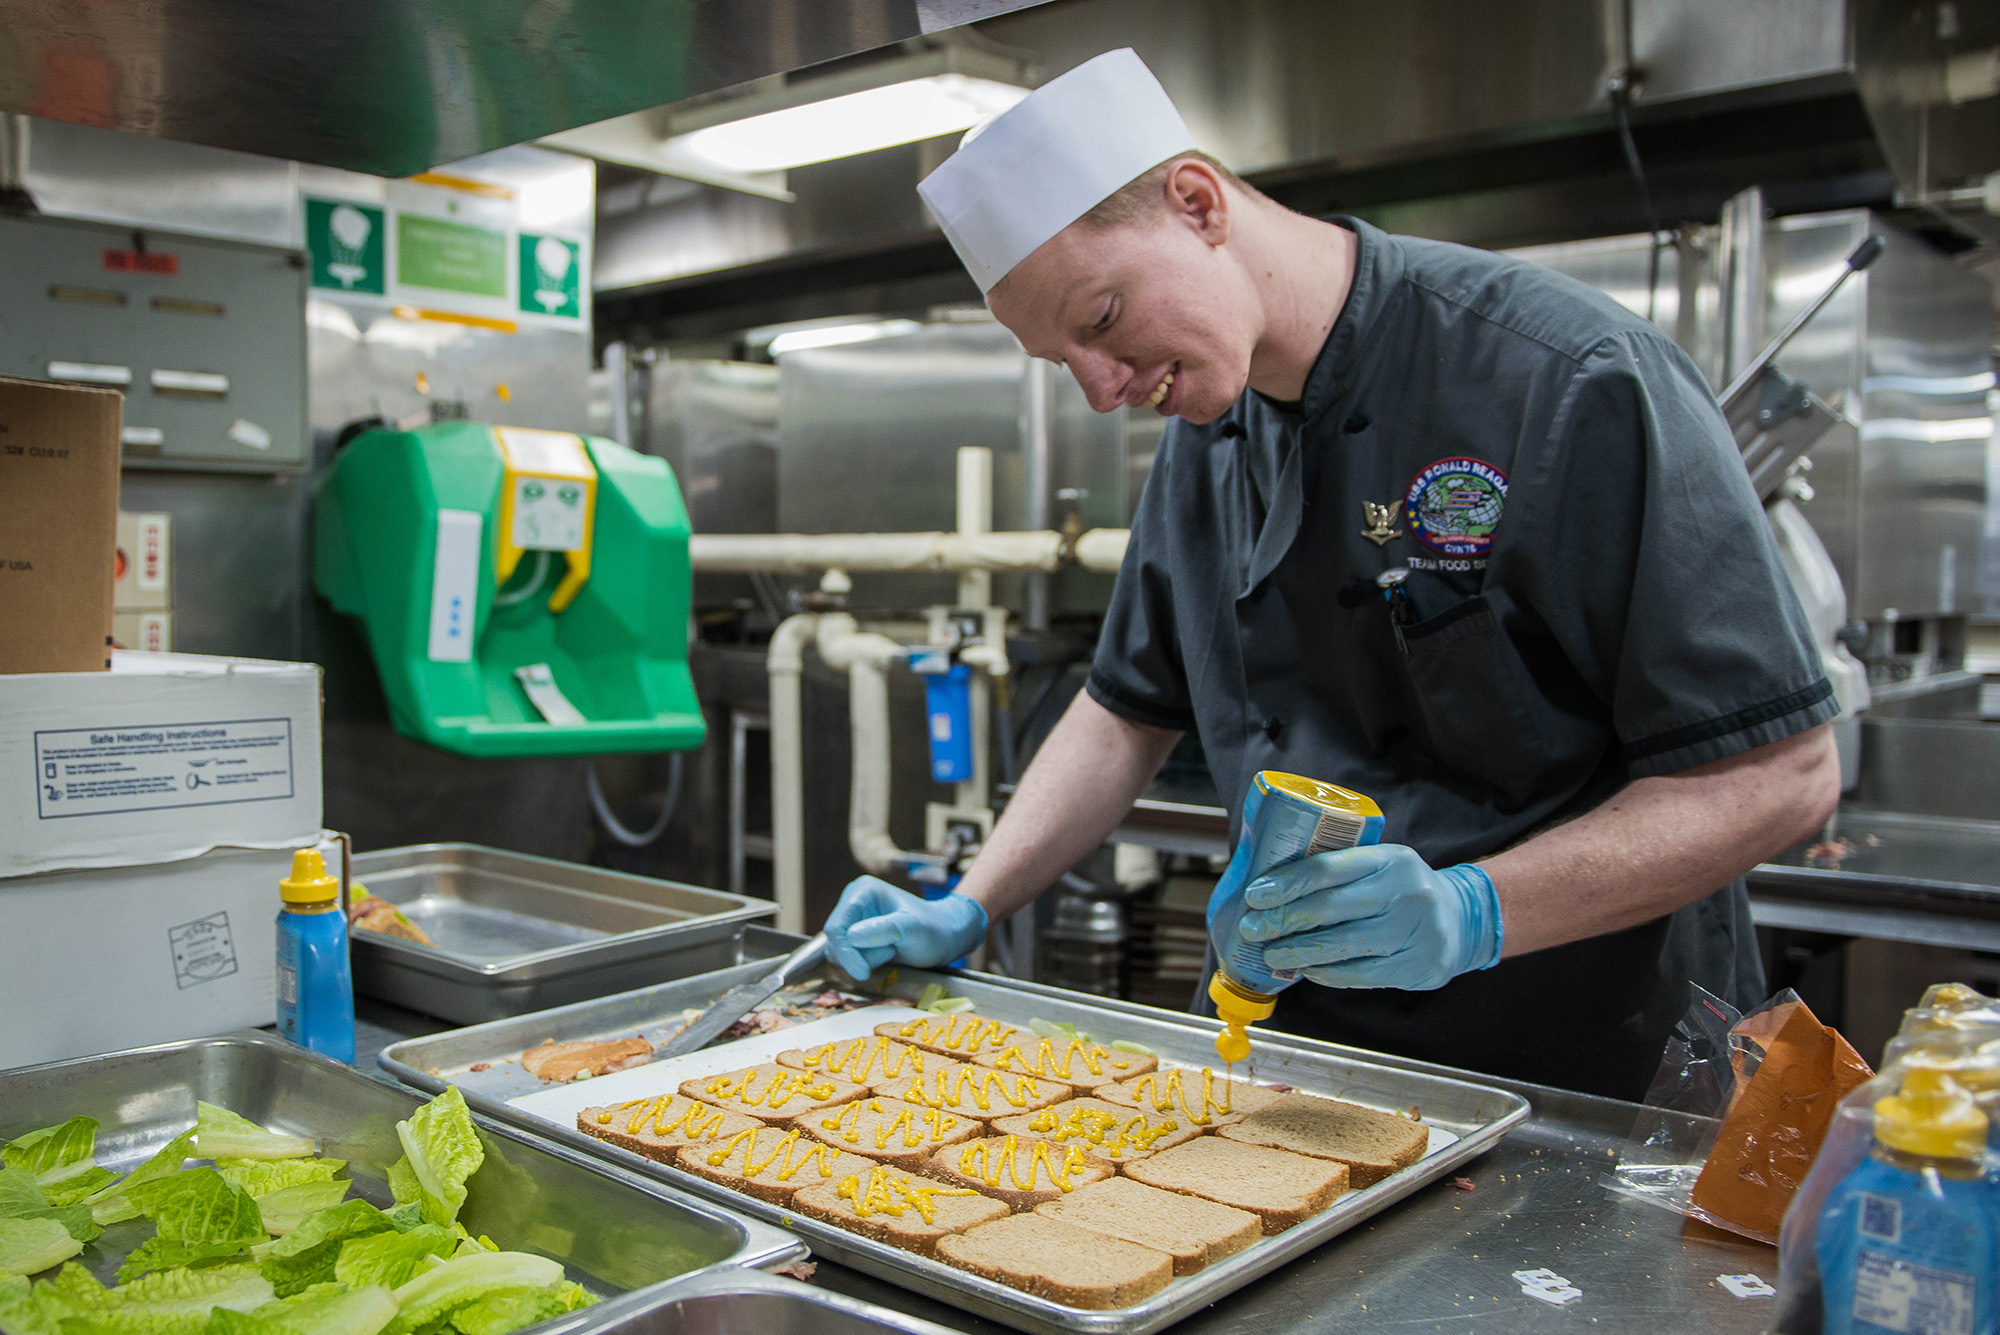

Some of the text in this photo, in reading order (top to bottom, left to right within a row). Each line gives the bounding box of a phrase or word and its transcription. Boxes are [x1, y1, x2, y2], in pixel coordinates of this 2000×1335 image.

[1408, 477, 1427, 502] USS
[1425, 460, 1471, 480] RONALD
[9, 560, 33, 570] USA
[1407, 556, 1438, 571] TEAM
[1438, 559, 1471, 571] FOOD
[90, 733, 114, 745] Safe
[117, 731, 164, 743] Handling
[167, 729, 226, 739] Instructions
